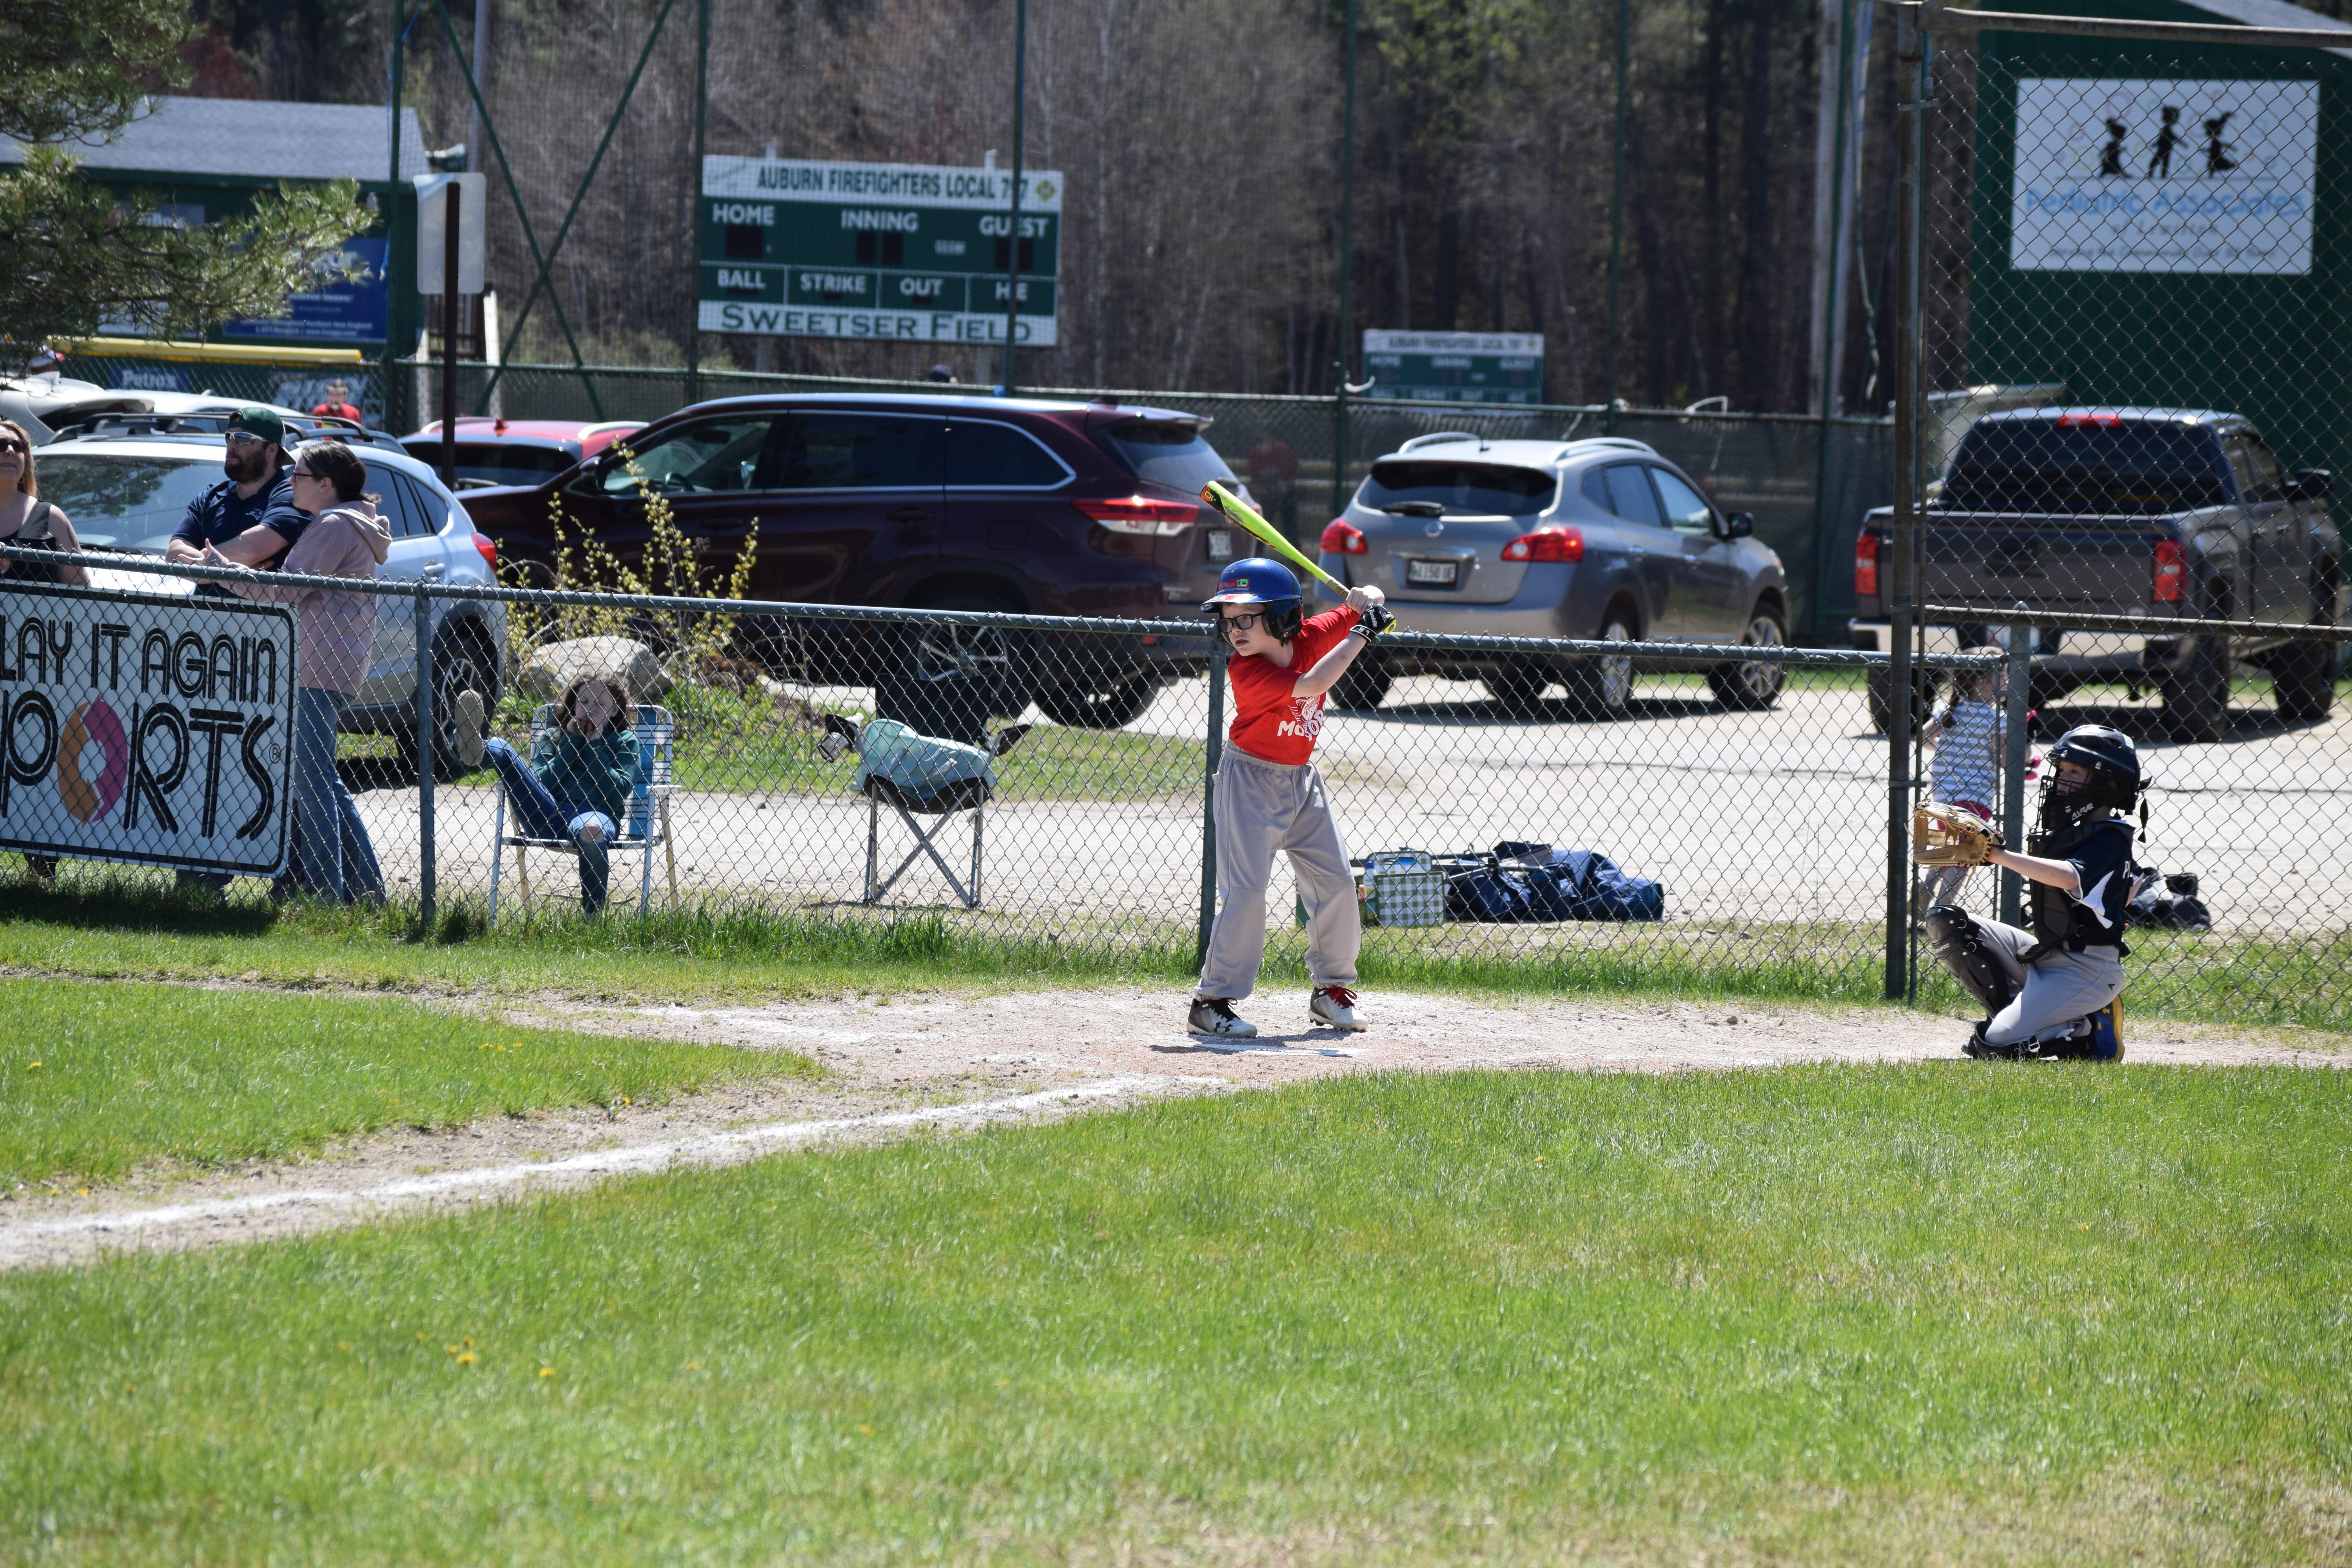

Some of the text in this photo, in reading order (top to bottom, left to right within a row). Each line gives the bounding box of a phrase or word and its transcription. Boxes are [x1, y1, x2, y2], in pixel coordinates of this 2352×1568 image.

[757, 166, 822, 191] AUBURN
[829, 170, 940, 196] FIREFIGHTERS
[946, 174, 995, 199] LOCAL
[1002, 178, 1028, 200] 77
[712, 203, 775, 226] HOME
[841, 209, 919, 232] INNING
[717, 269, 766, 289] BALL
[800, 273, 867, 293] STRIKE
[900, 277, 943, 297] OUT
[995, 281, 1028, 301] HE
[721, 304, 1031, 341] SWEETSER FIELD
[91, 623, 130, 690] IT
